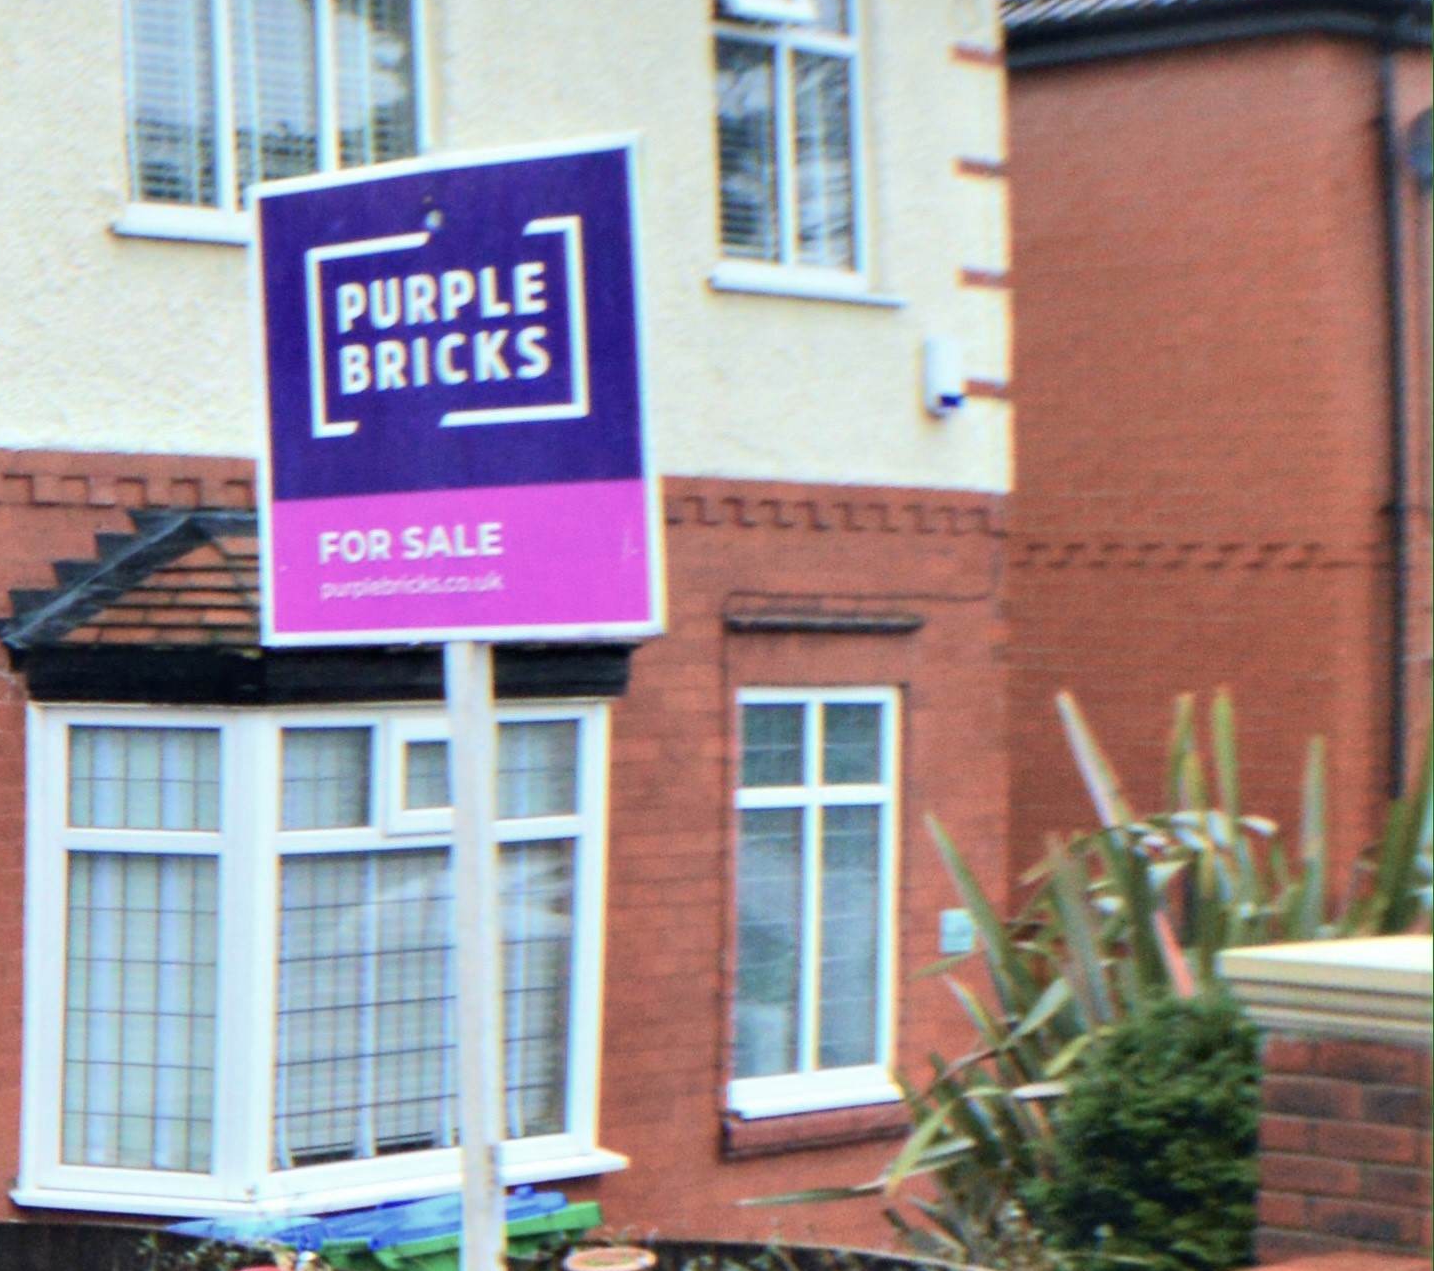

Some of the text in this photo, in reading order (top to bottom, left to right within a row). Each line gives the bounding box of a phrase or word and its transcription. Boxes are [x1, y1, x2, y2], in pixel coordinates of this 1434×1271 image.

[336, 262, 547, 333] PURPLE
[340, 327, 551, 394] BRICKS
[319, 522, 503, 564] FOR SALE
